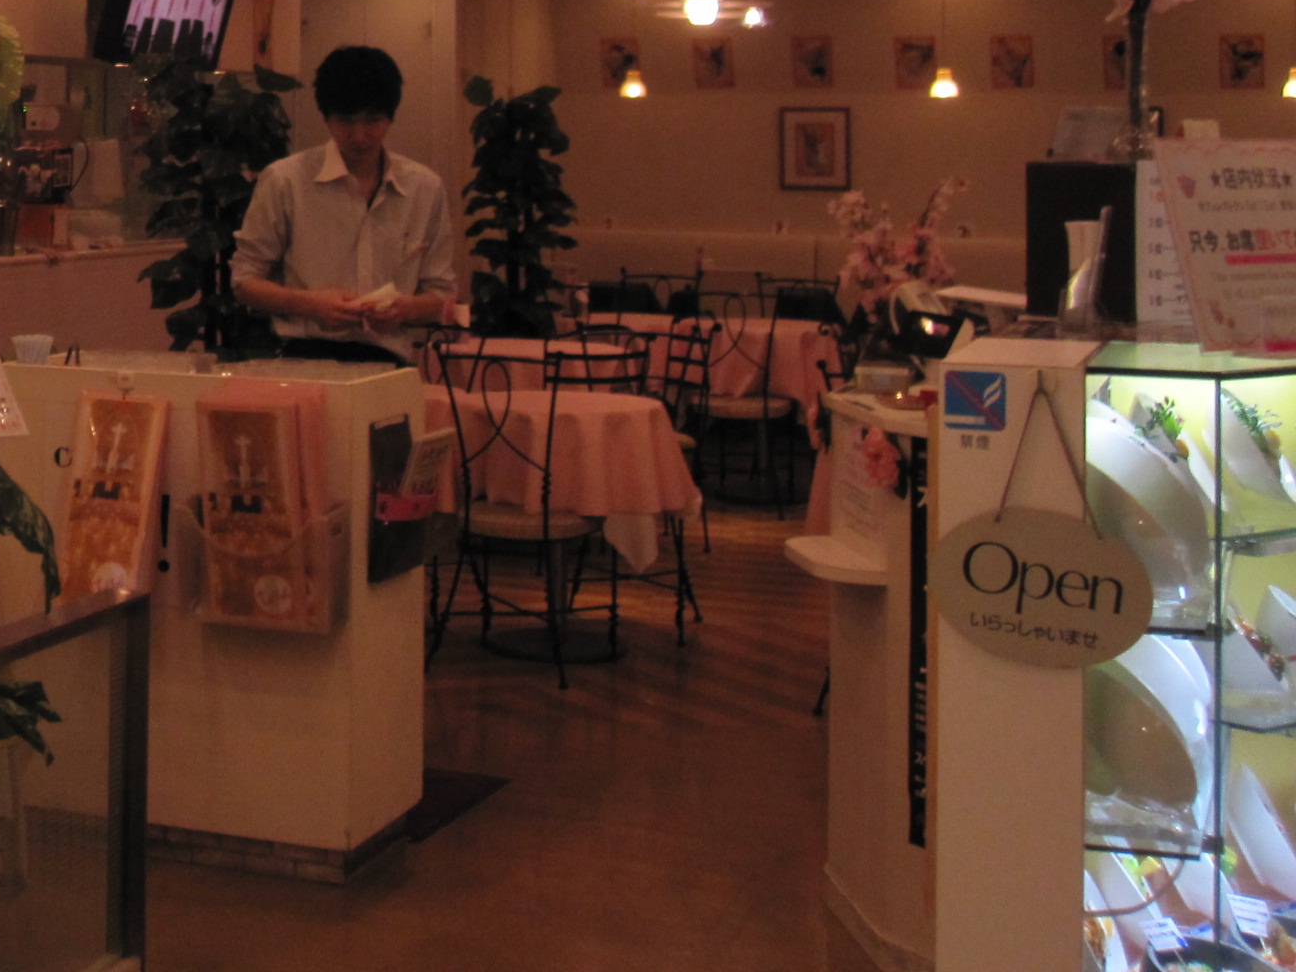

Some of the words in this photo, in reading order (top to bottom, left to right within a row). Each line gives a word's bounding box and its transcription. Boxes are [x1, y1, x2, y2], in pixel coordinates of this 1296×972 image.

[960, 434, 990, 451] 禁煙
[962, 541, 1124, 615] Open
[969, 612, 1099, 649] いらっしゃいませ
